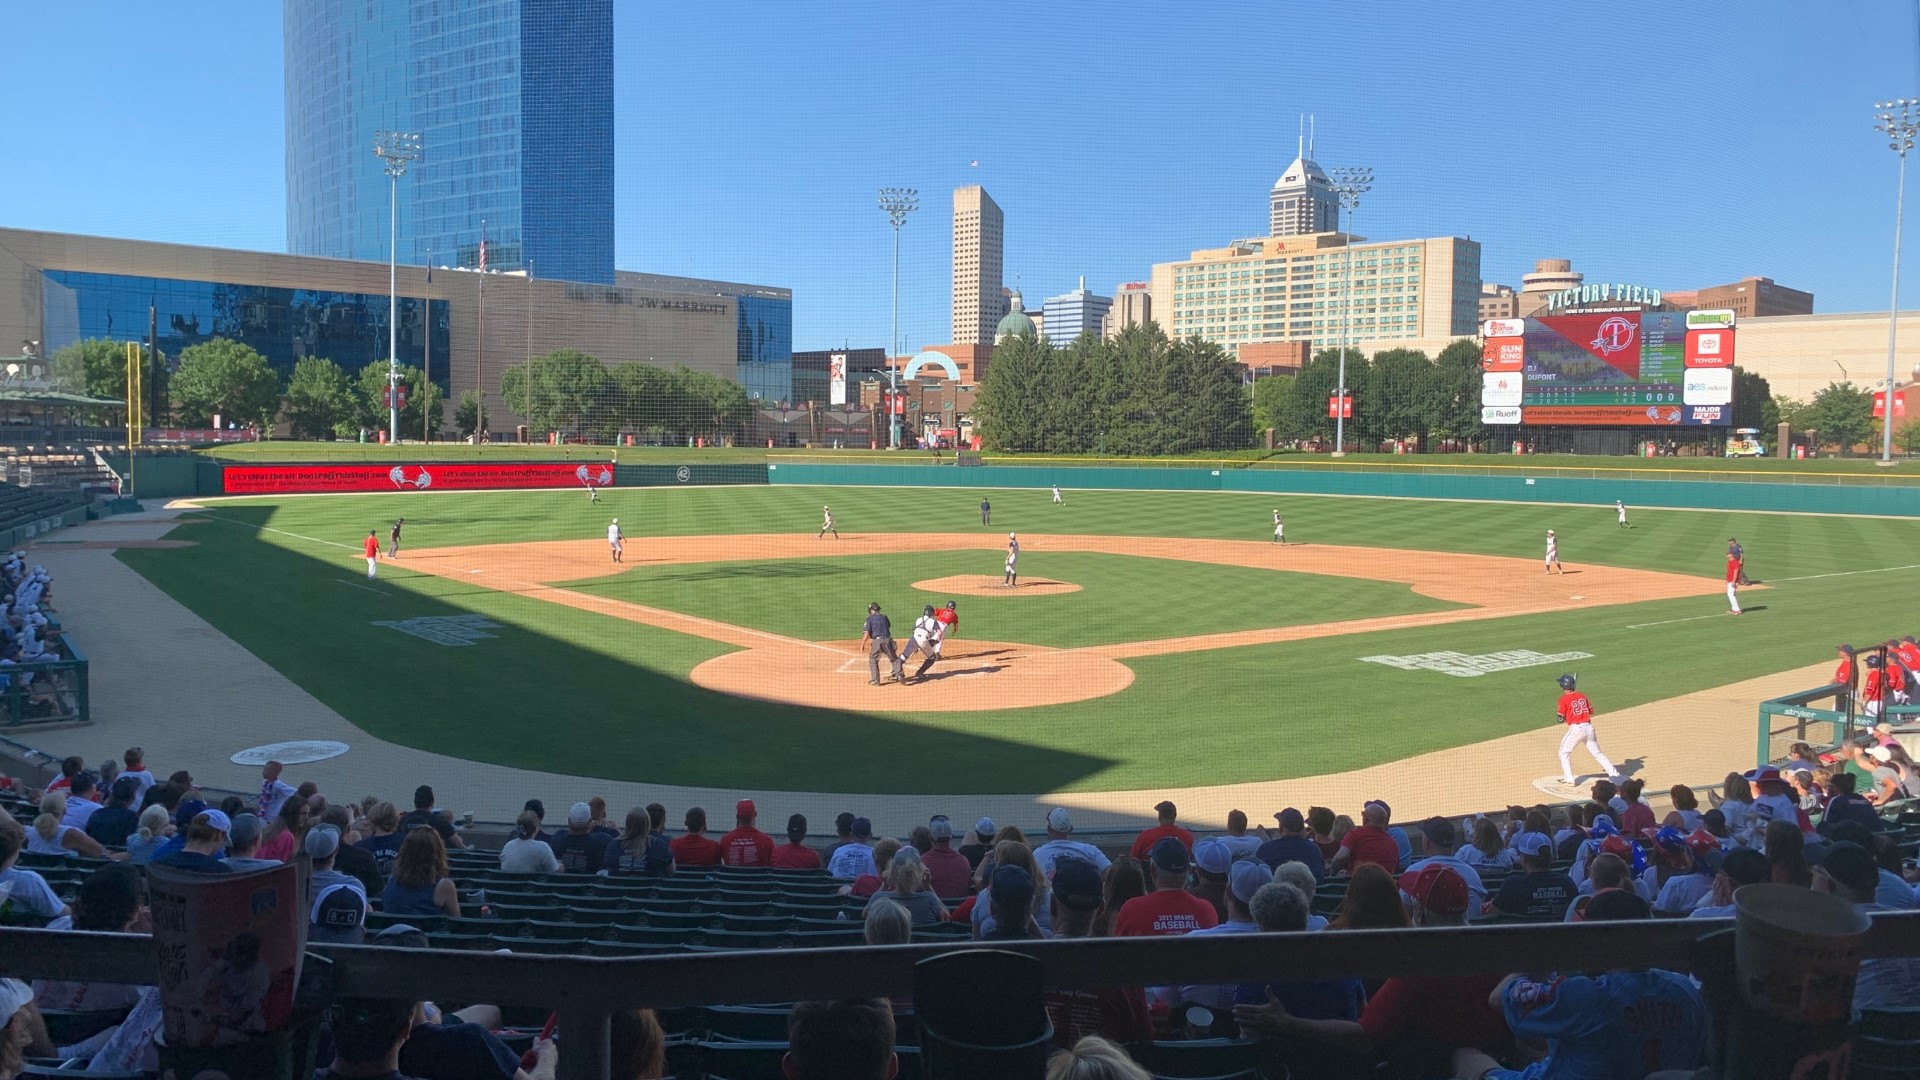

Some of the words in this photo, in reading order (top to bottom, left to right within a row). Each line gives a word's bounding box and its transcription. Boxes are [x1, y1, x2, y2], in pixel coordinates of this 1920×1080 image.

[1125, 283, 1147, 291] Hilton
[1547, 282, 1611, 311] VICTORY
[1615, 283, 1661, 307] FIELD
[639, 297, 659, 309] JW
[660, 299, 728, 315] MARRIOTT
[1500, 345, 1522, 353] SUN
[1527, 373, 1557, 381] DUPONT
[1687, 383, 1706, 391] aes
[1495, 410, 1518, 418] Ruoff
[1571, 698, 1589, 716] 22
[1783, 708, 1817, 718] stryker
[1838, 714, 1872, 726] stker
[1532, 891, 1567, 899] BASEBALL
[1153, 920, 1201, 931] BASEBALL
